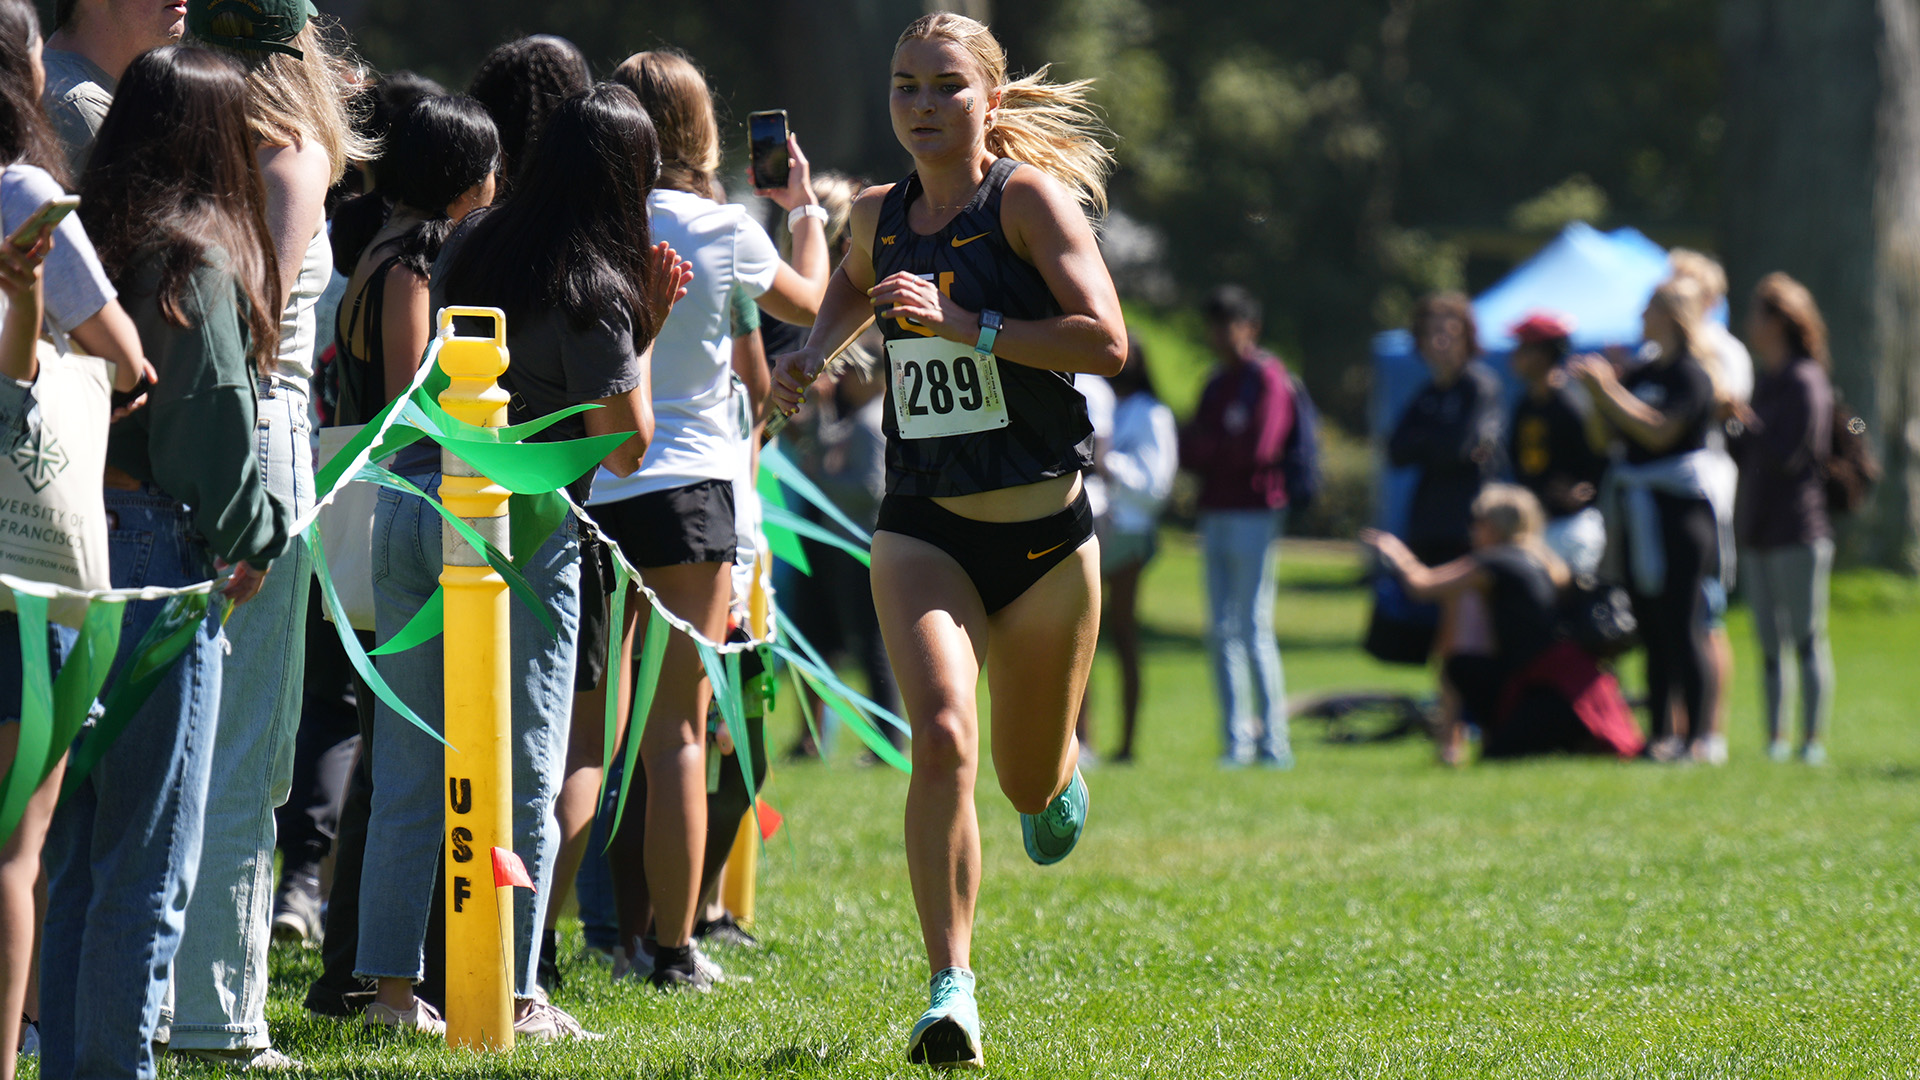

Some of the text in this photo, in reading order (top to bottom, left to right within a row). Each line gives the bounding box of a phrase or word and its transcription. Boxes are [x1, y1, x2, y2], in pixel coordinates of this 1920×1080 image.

[904, 357, 983, 416] 289
[0, 518, 82, 549] FRANCISCO
[70, 513, 84, 528] OF
[5, 551, 34, 565] WORLD
[35, 558, 58, 570] FROM
[58, 563, 80, 576] HERE
[449, 777, 473, 913] USF
